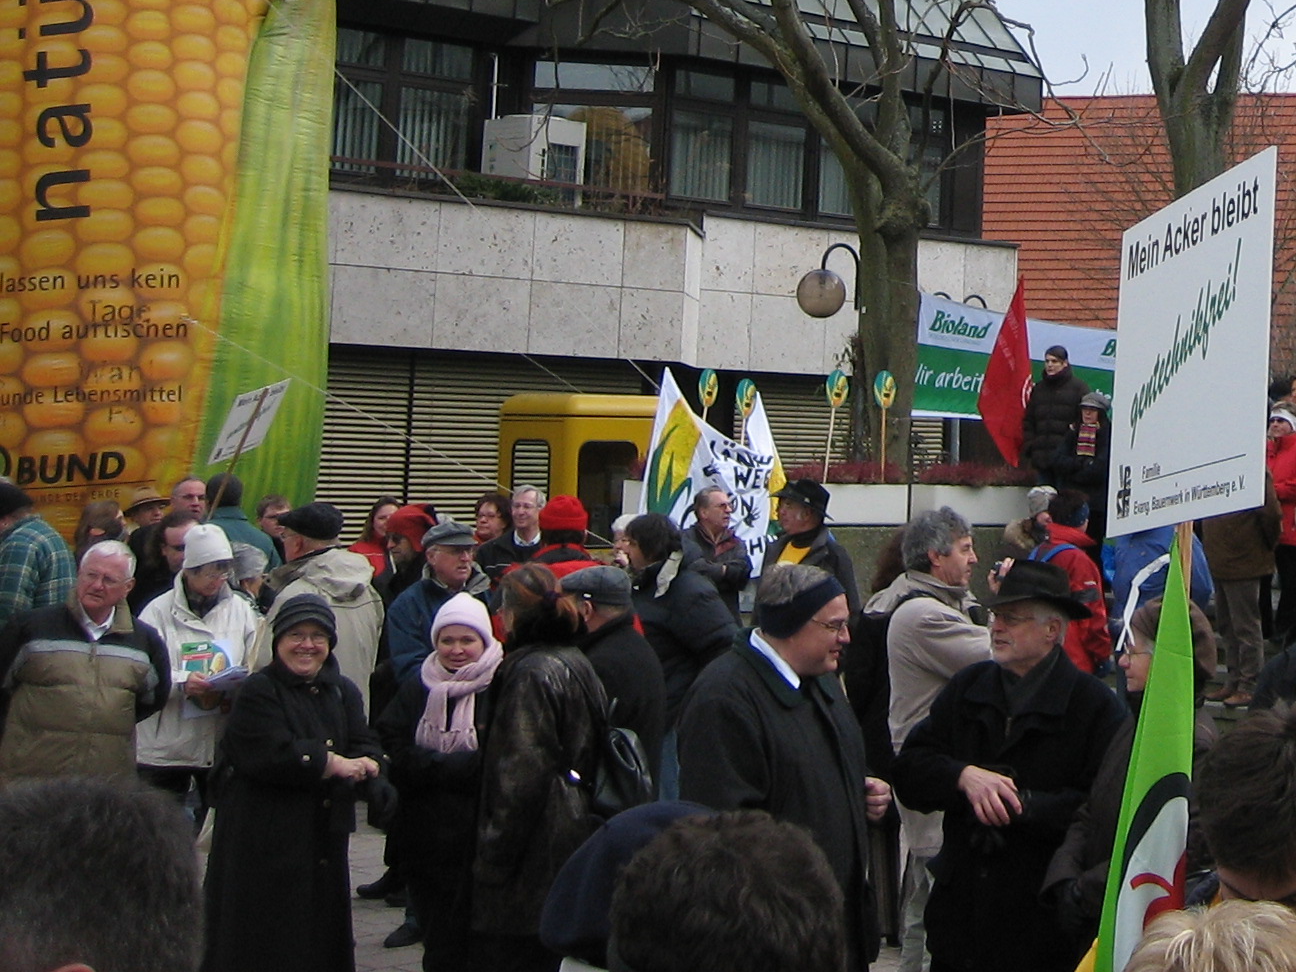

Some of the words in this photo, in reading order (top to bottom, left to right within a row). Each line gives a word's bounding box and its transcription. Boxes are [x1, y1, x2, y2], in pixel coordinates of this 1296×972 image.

[1127, 233, 1160, 281] Mein
[1161, 212, 1208, 262] Acker
[1210, 175, 1259, 237] bleibt
[77, 273, 120, 290] uns
[131, 267, 180, 289] kein
[0, 321, 50, 344] Food
[928, 309, 993, 340] Bioland
[1130, 237, 1242, 450] gentechnikfrei!
[53, 384, 182, 404] Lebensmittel
[16, 451, 126, 485] BUND
